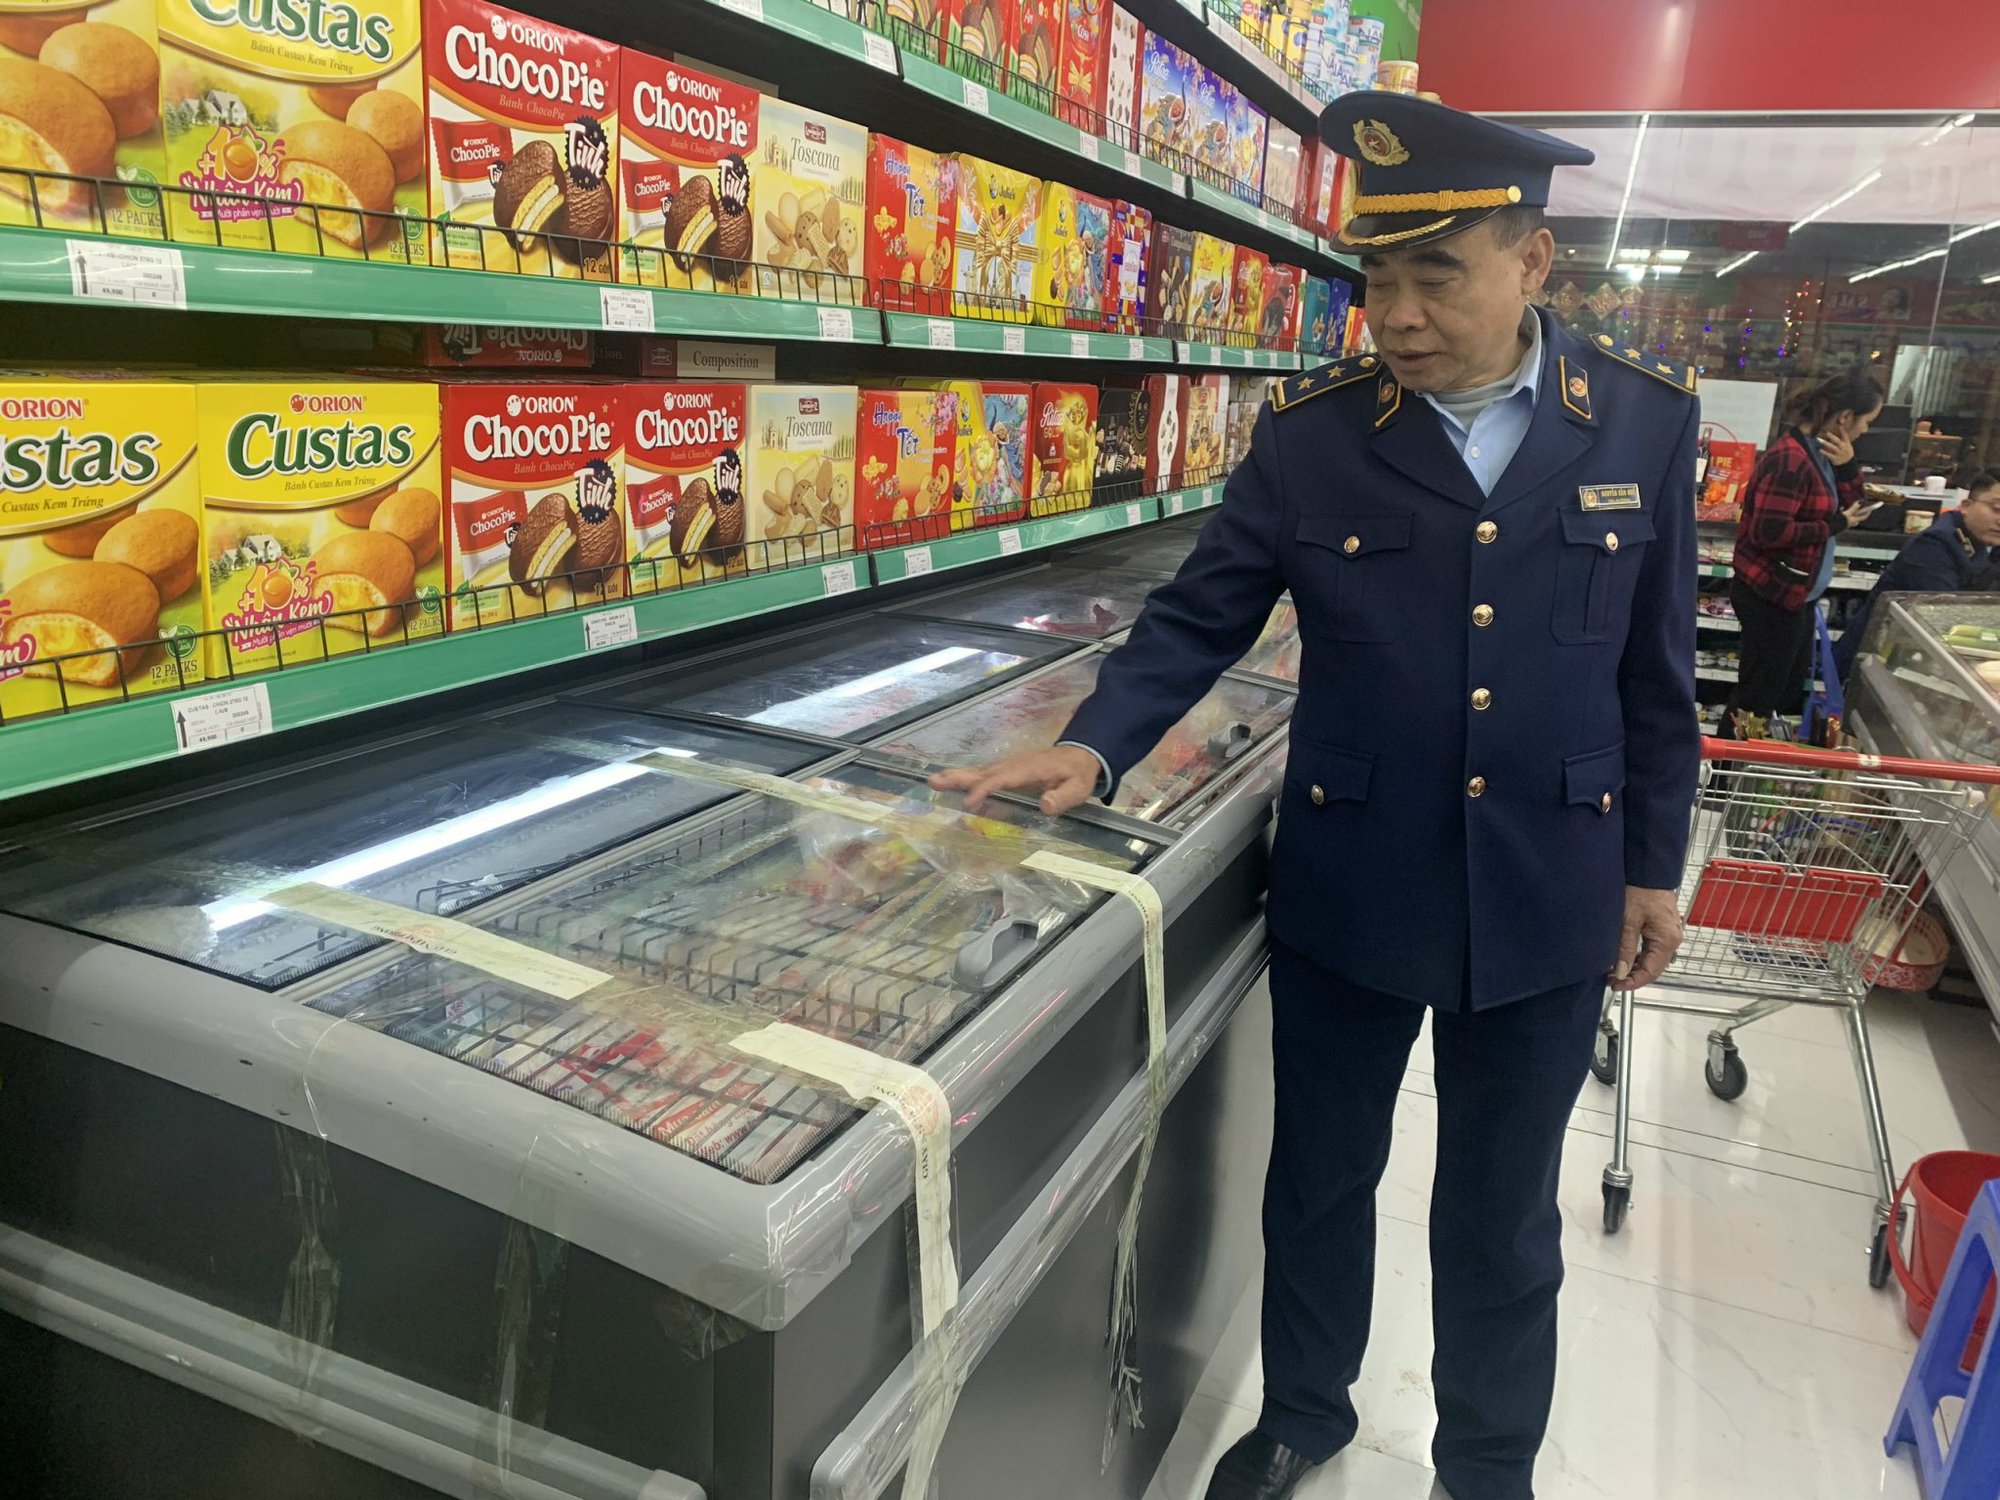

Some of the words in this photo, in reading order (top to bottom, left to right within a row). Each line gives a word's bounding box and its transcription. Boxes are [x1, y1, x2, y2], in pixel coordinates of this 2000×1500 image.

[511, 24, 564, 56] ORION
[277, 46, 306, 62] Custas
[307, 52, 327, 66] Kem
[445, 25, 605, 110] ChocoPie
[681, 77, 719, 102] ORION
[633, 81, 748, 147] ChocoPie
[450, 145, 500, 163] ChocoPie
[791, 137, 840, 172] Toscana
[111, 209, 124, 223] 12
[388, 241, 398, 254] 12
[400, 244, 424, 256] PCKS
[584, 256, 597, 273] 12
[519, 350, 552, 362] ORION
[693, 351, 759, 372] Composition
[1, 399, 82, 419] ORION
[309, 396, 363, 412] ORION
[525, 396, 575, 413] ORION
[677, 394, 711, 409] ORION
[464, 412, 611, 462] ChocoPie
[635, 406, 739, 450] ChocoPie
[786, 416, 832, 438] Toscana
[227, 414, 412, 477] Custas
[0, 428, 157, 489] stas
[308, 479, 334, 490] Custas
[335, 477, 352, 487] Kem
[2, 501, 40, 513] Custas
[43, 498, 68, 511] Kem
[470, 510, 516, 537] ChocoPie
[150, 666, 162, 680] 12
